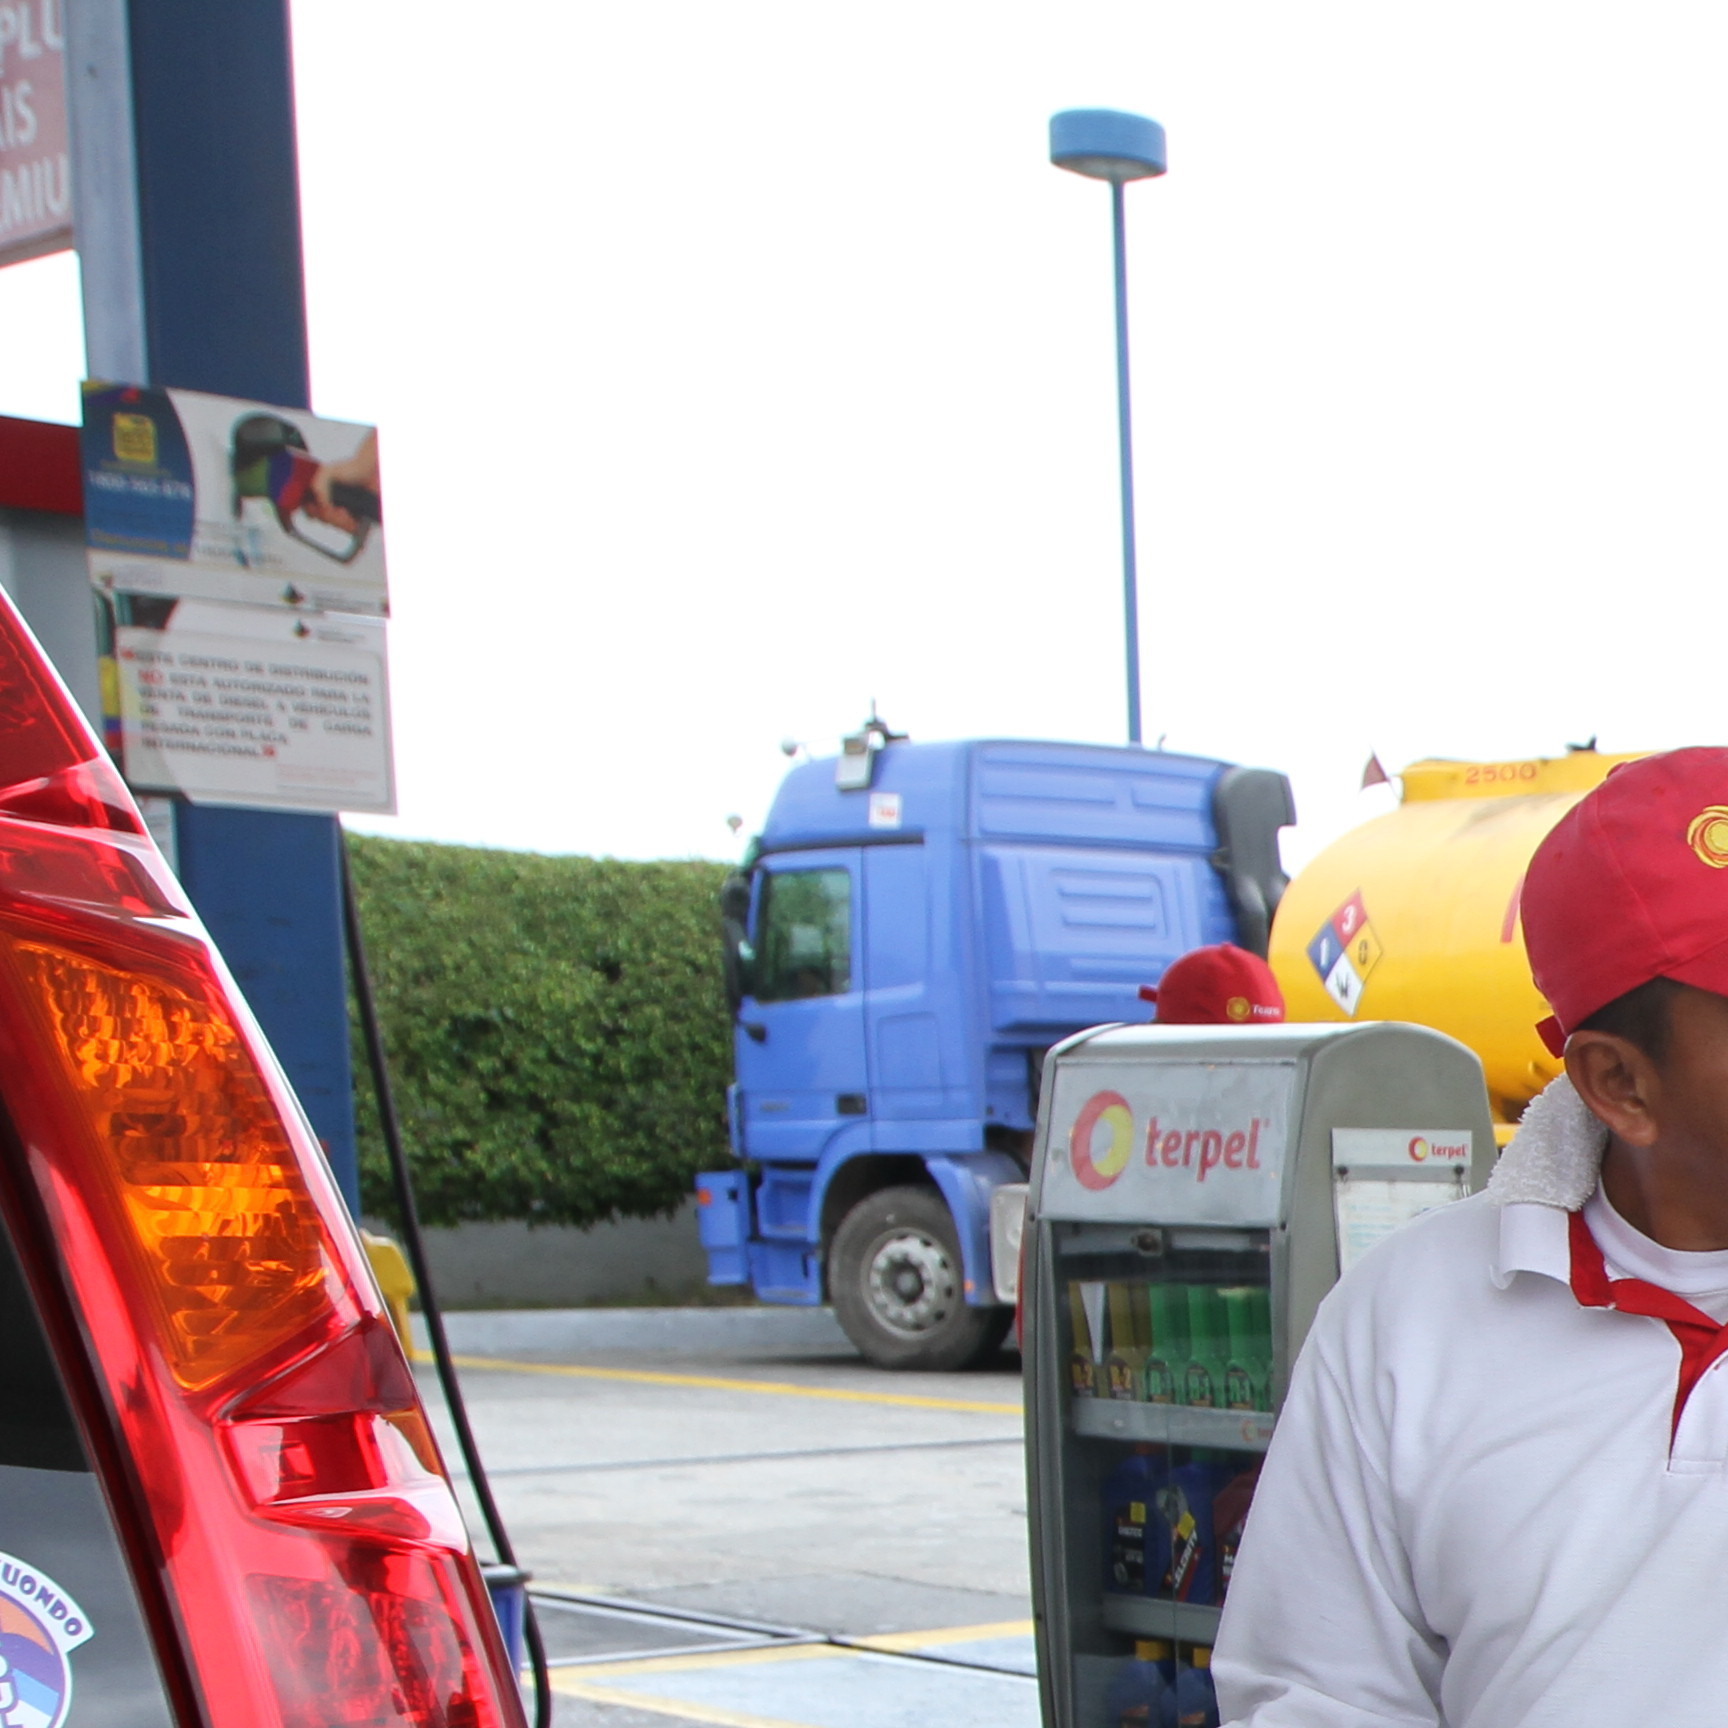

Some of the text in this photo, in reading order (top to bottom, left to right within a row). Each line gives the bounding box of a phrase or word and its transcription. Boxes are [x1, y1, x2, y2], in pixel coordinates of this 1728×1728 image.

[1465, 764, 1537, 785] 2500
[1341, 904, 1356, 934] 3
[1146, 1116, 1260, 1183] terpel
[1431, 1143, 1466, 1160] terpel
